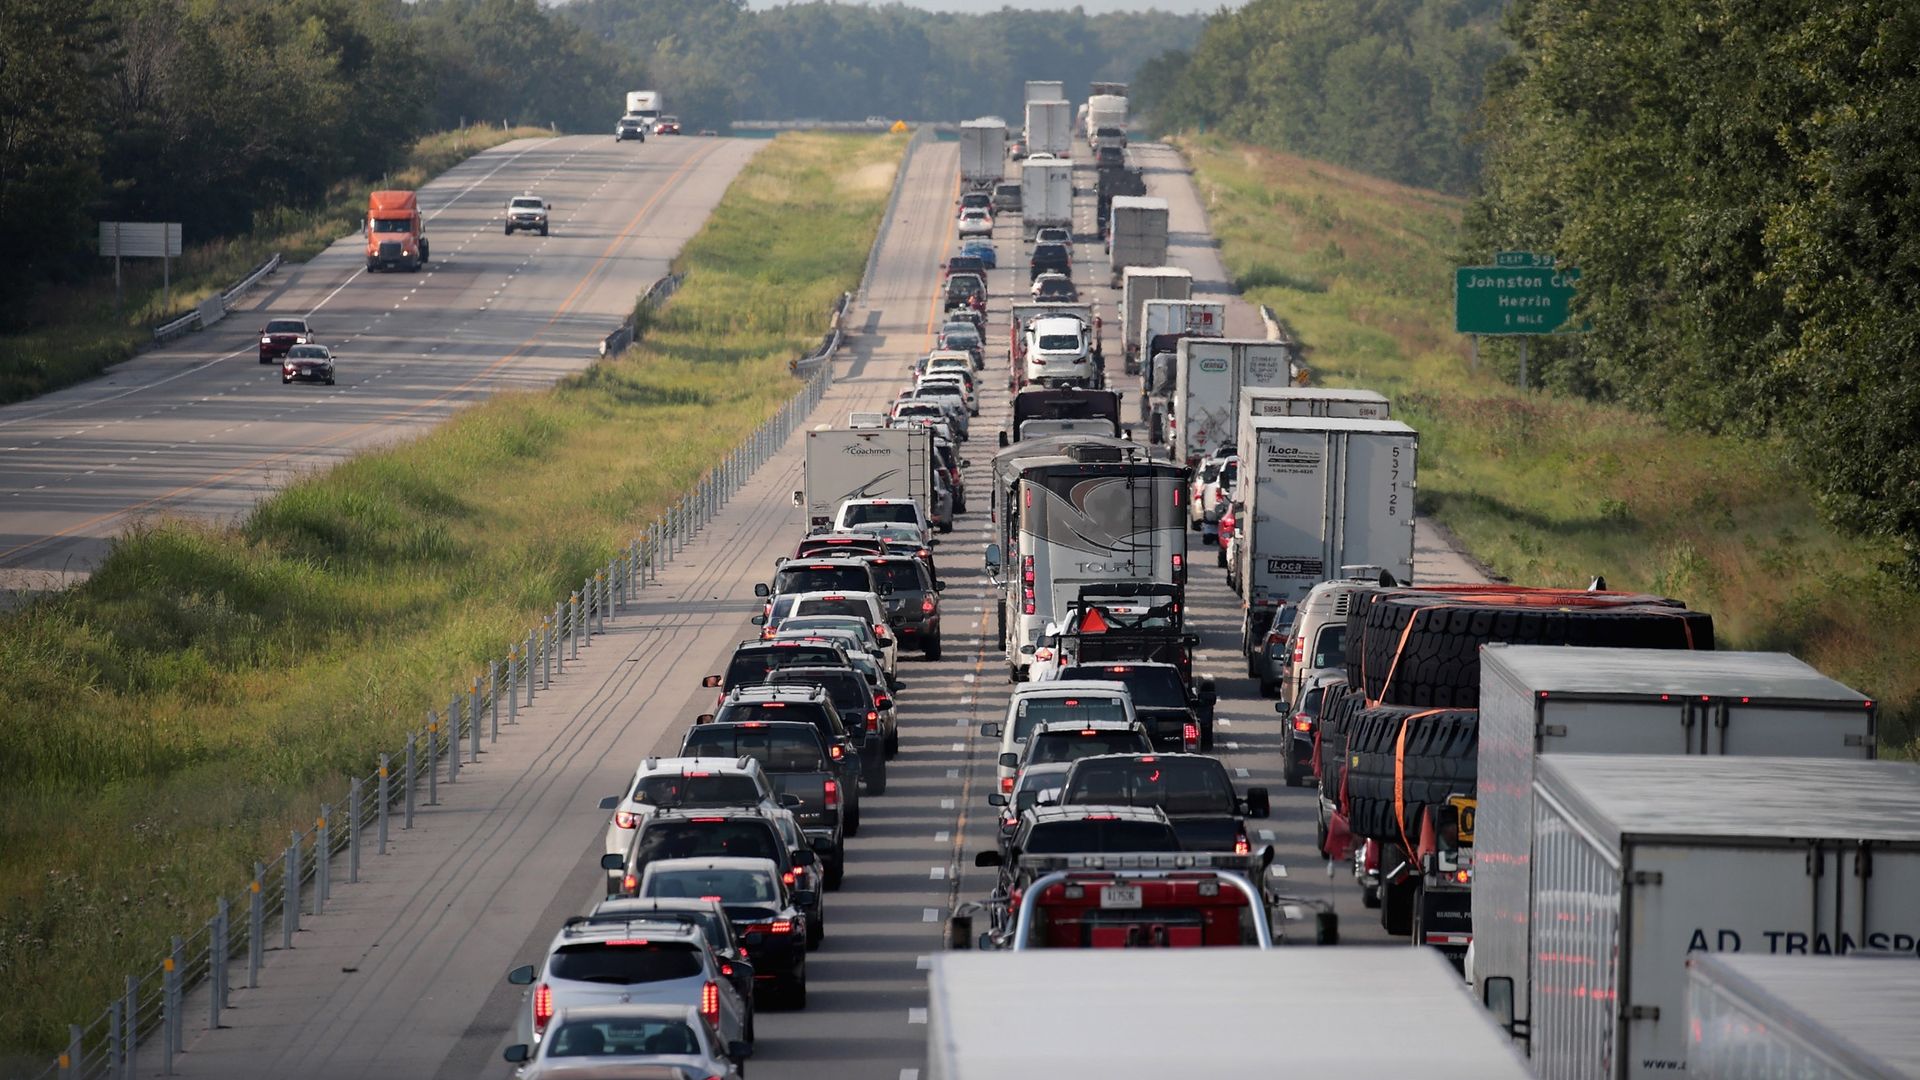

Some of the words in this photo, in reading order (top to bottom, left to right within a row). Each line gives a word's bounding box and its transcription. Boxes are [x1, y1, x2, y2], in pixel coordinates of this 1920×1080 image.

[1466, 275, 1542, 288] Johnston
[1498, 295, 1551, 307] Herrin
[1504, 313, 1511, 325] 1
[1074, 562, 1130, 574] TOUR
